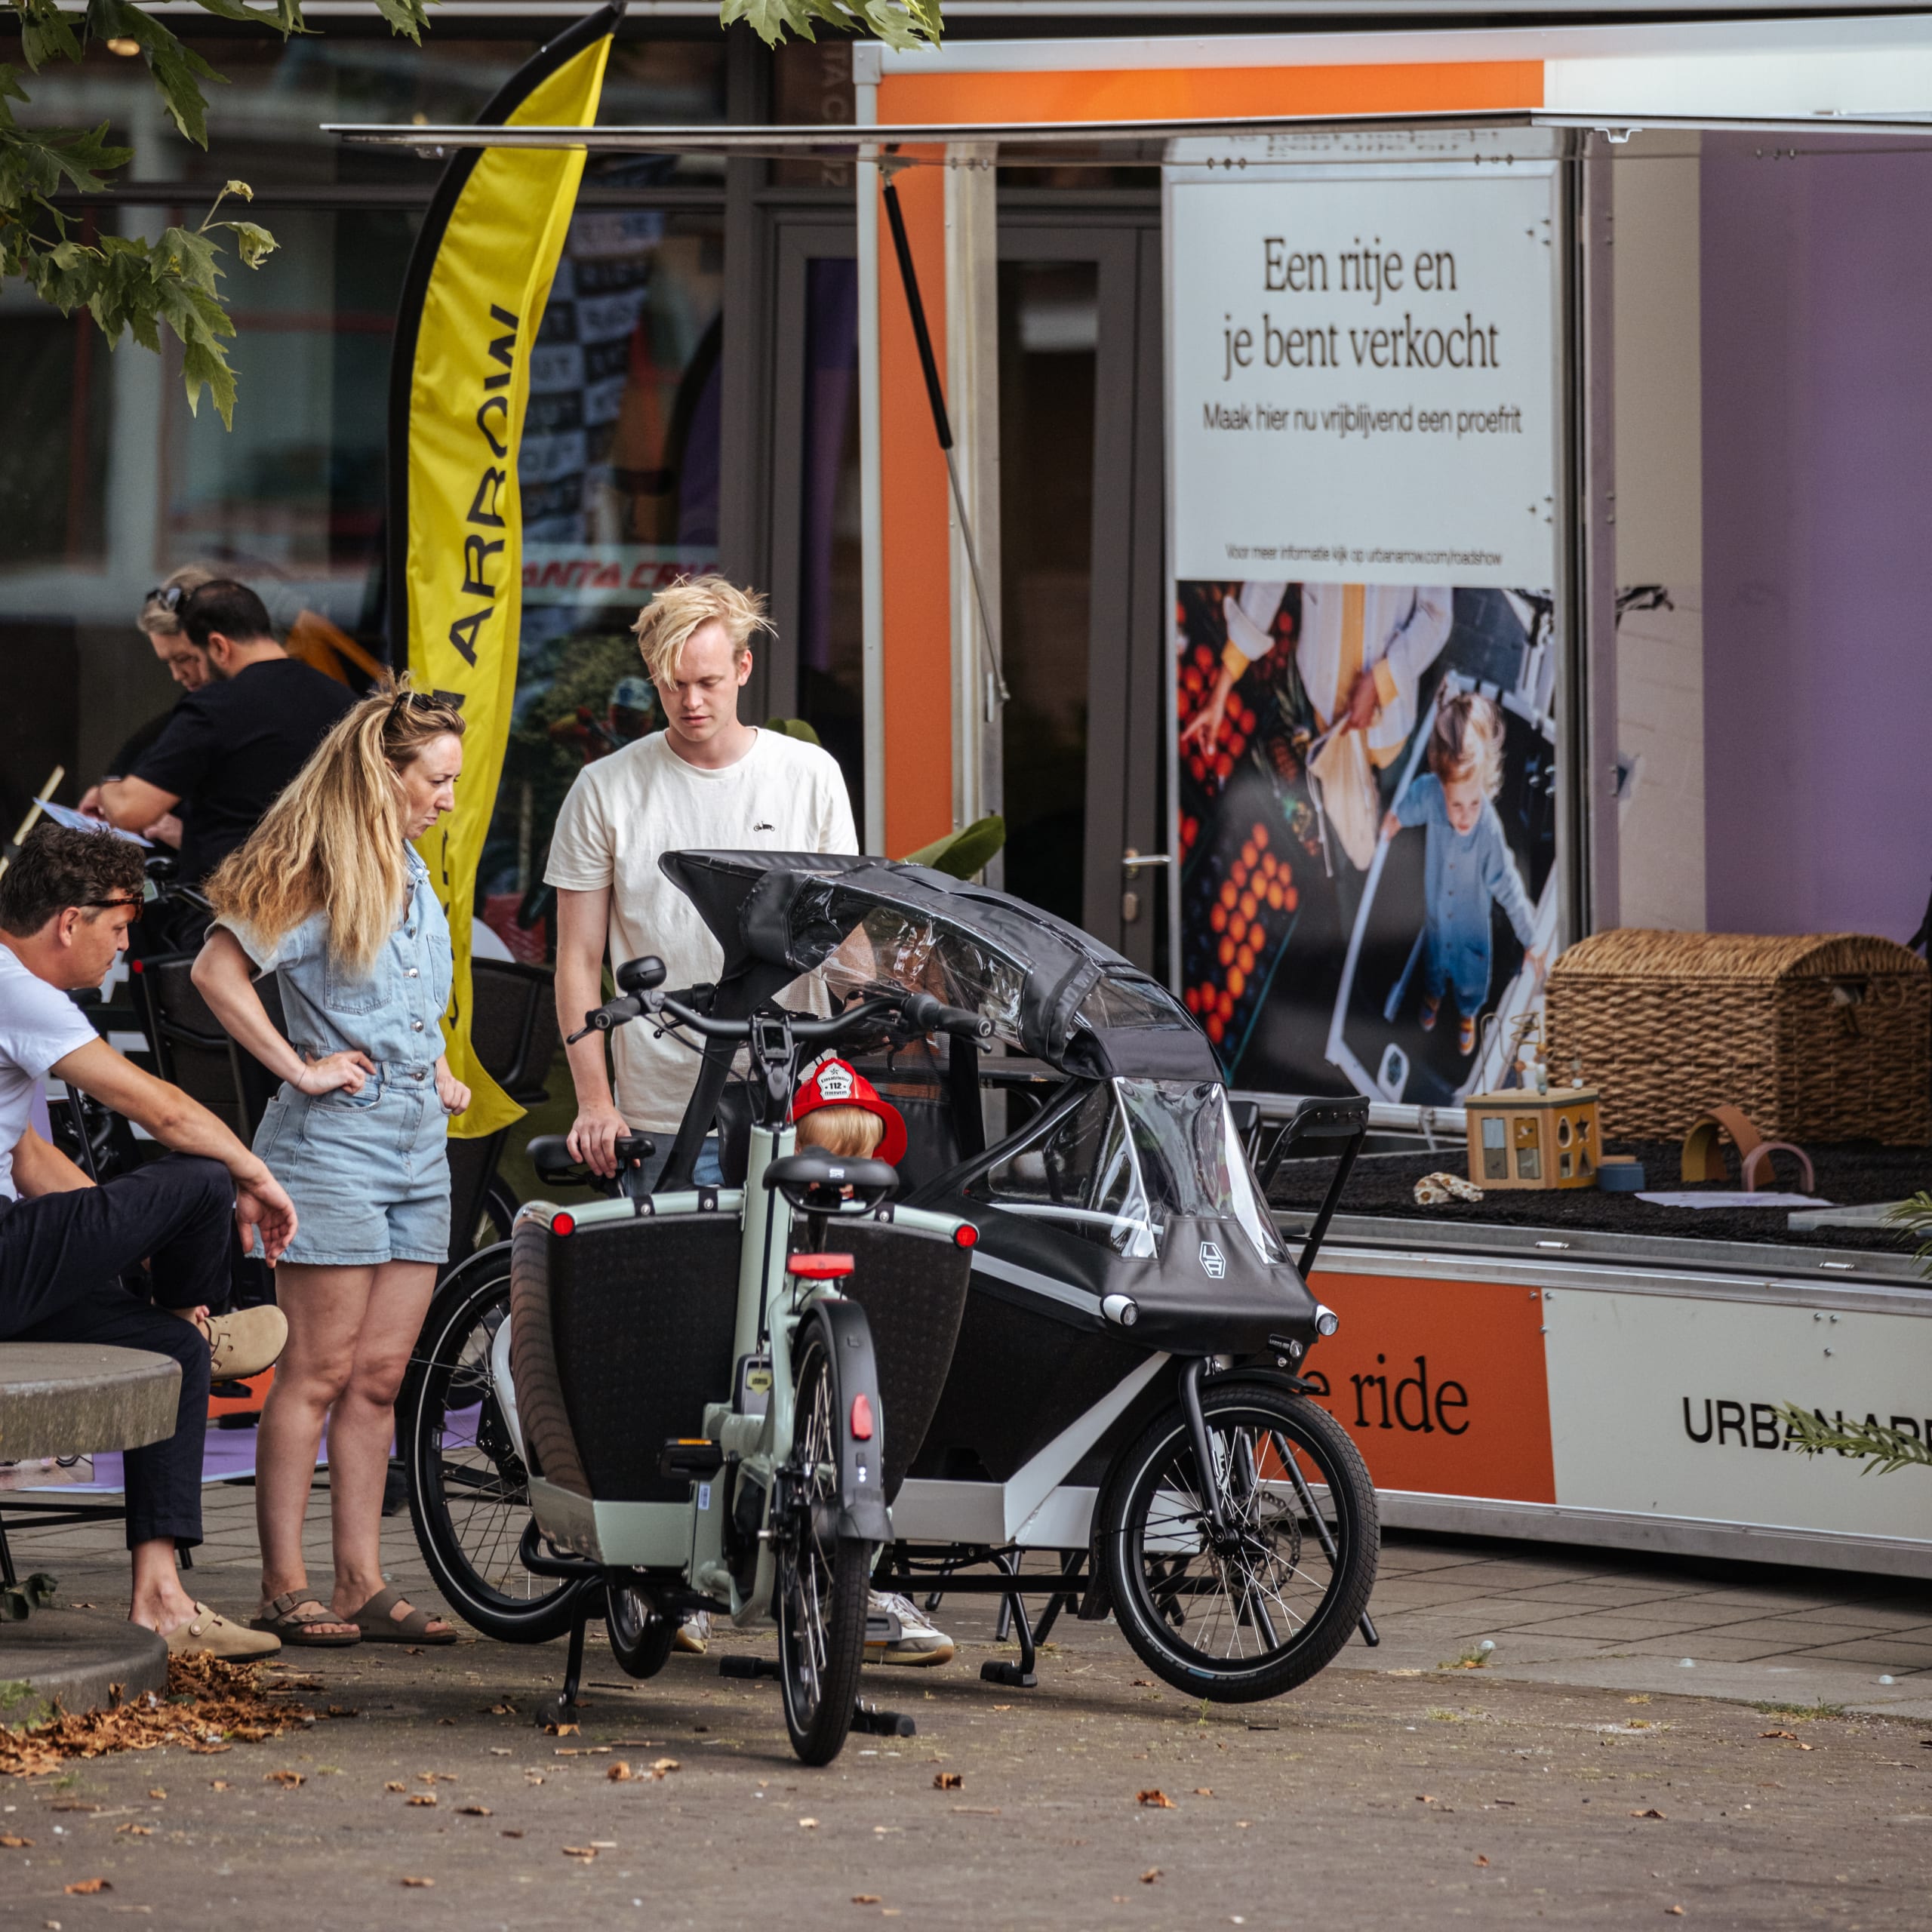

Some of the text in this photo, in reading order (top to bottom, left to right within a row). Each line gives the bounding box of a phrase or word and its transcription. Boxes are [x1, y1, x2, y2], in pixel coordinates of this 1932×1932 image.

[1263, 235, 1457, 306] Een ritje en
[1223, 311, 1501, 382] je bent verkocht
[1204, 404, 1522, 439] Maak hier nu vrijblijvend een proefrit
[1225, 543, 1250, 560] Voor
[1251, 546, 1277, 561] meer
[1281, 545, 1330, 561] informatie
[1349, 1352, 1470, 1436] ride
